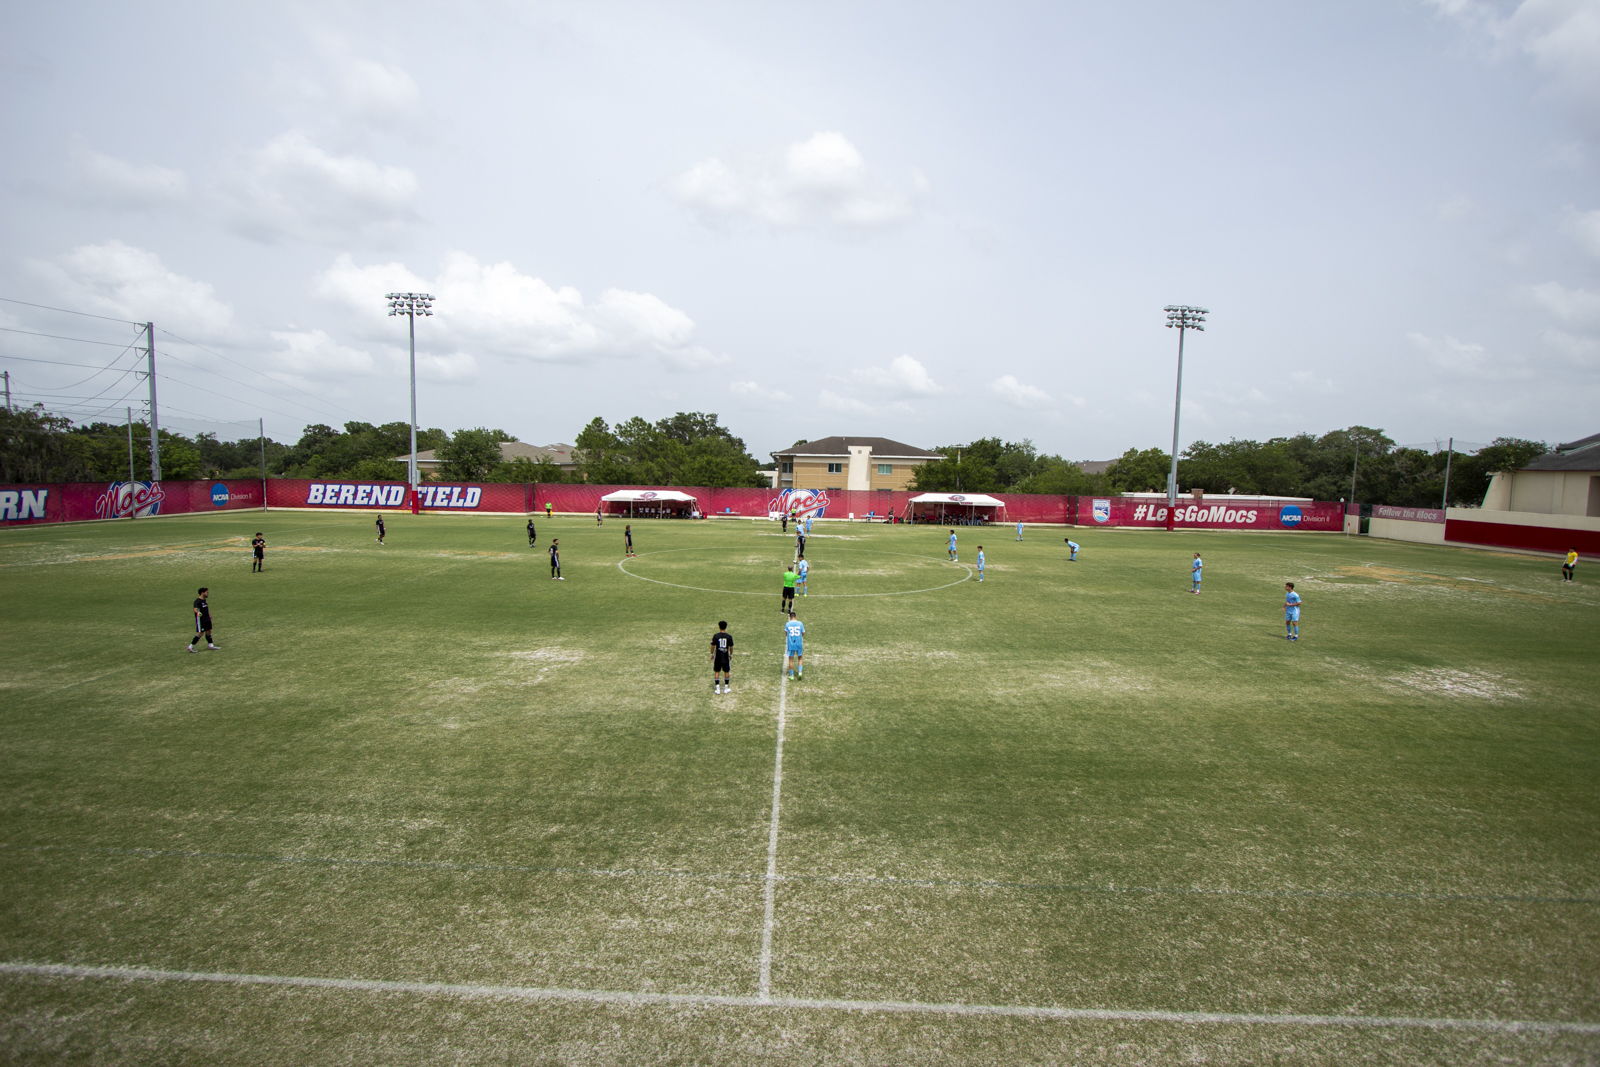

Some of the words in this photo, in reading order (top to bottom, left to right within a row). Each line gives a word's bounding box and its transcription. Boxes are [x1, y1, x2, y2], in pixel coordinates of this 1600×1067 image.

[95, 482, 165, 519] Mocs
[306, 484, 405, 506] BEREND
[768, 490, 830, 517] Mocs
[1133, 504, 1258, 523] #LesGoMocs
[1378, 507, 1401, 517] Follow
[1403, 509, 1414, 518] the
[1416, 510, 1437, 520] Mocs
[788, 626, 801, 636] 35
[718, 638, 727, 648] 10
